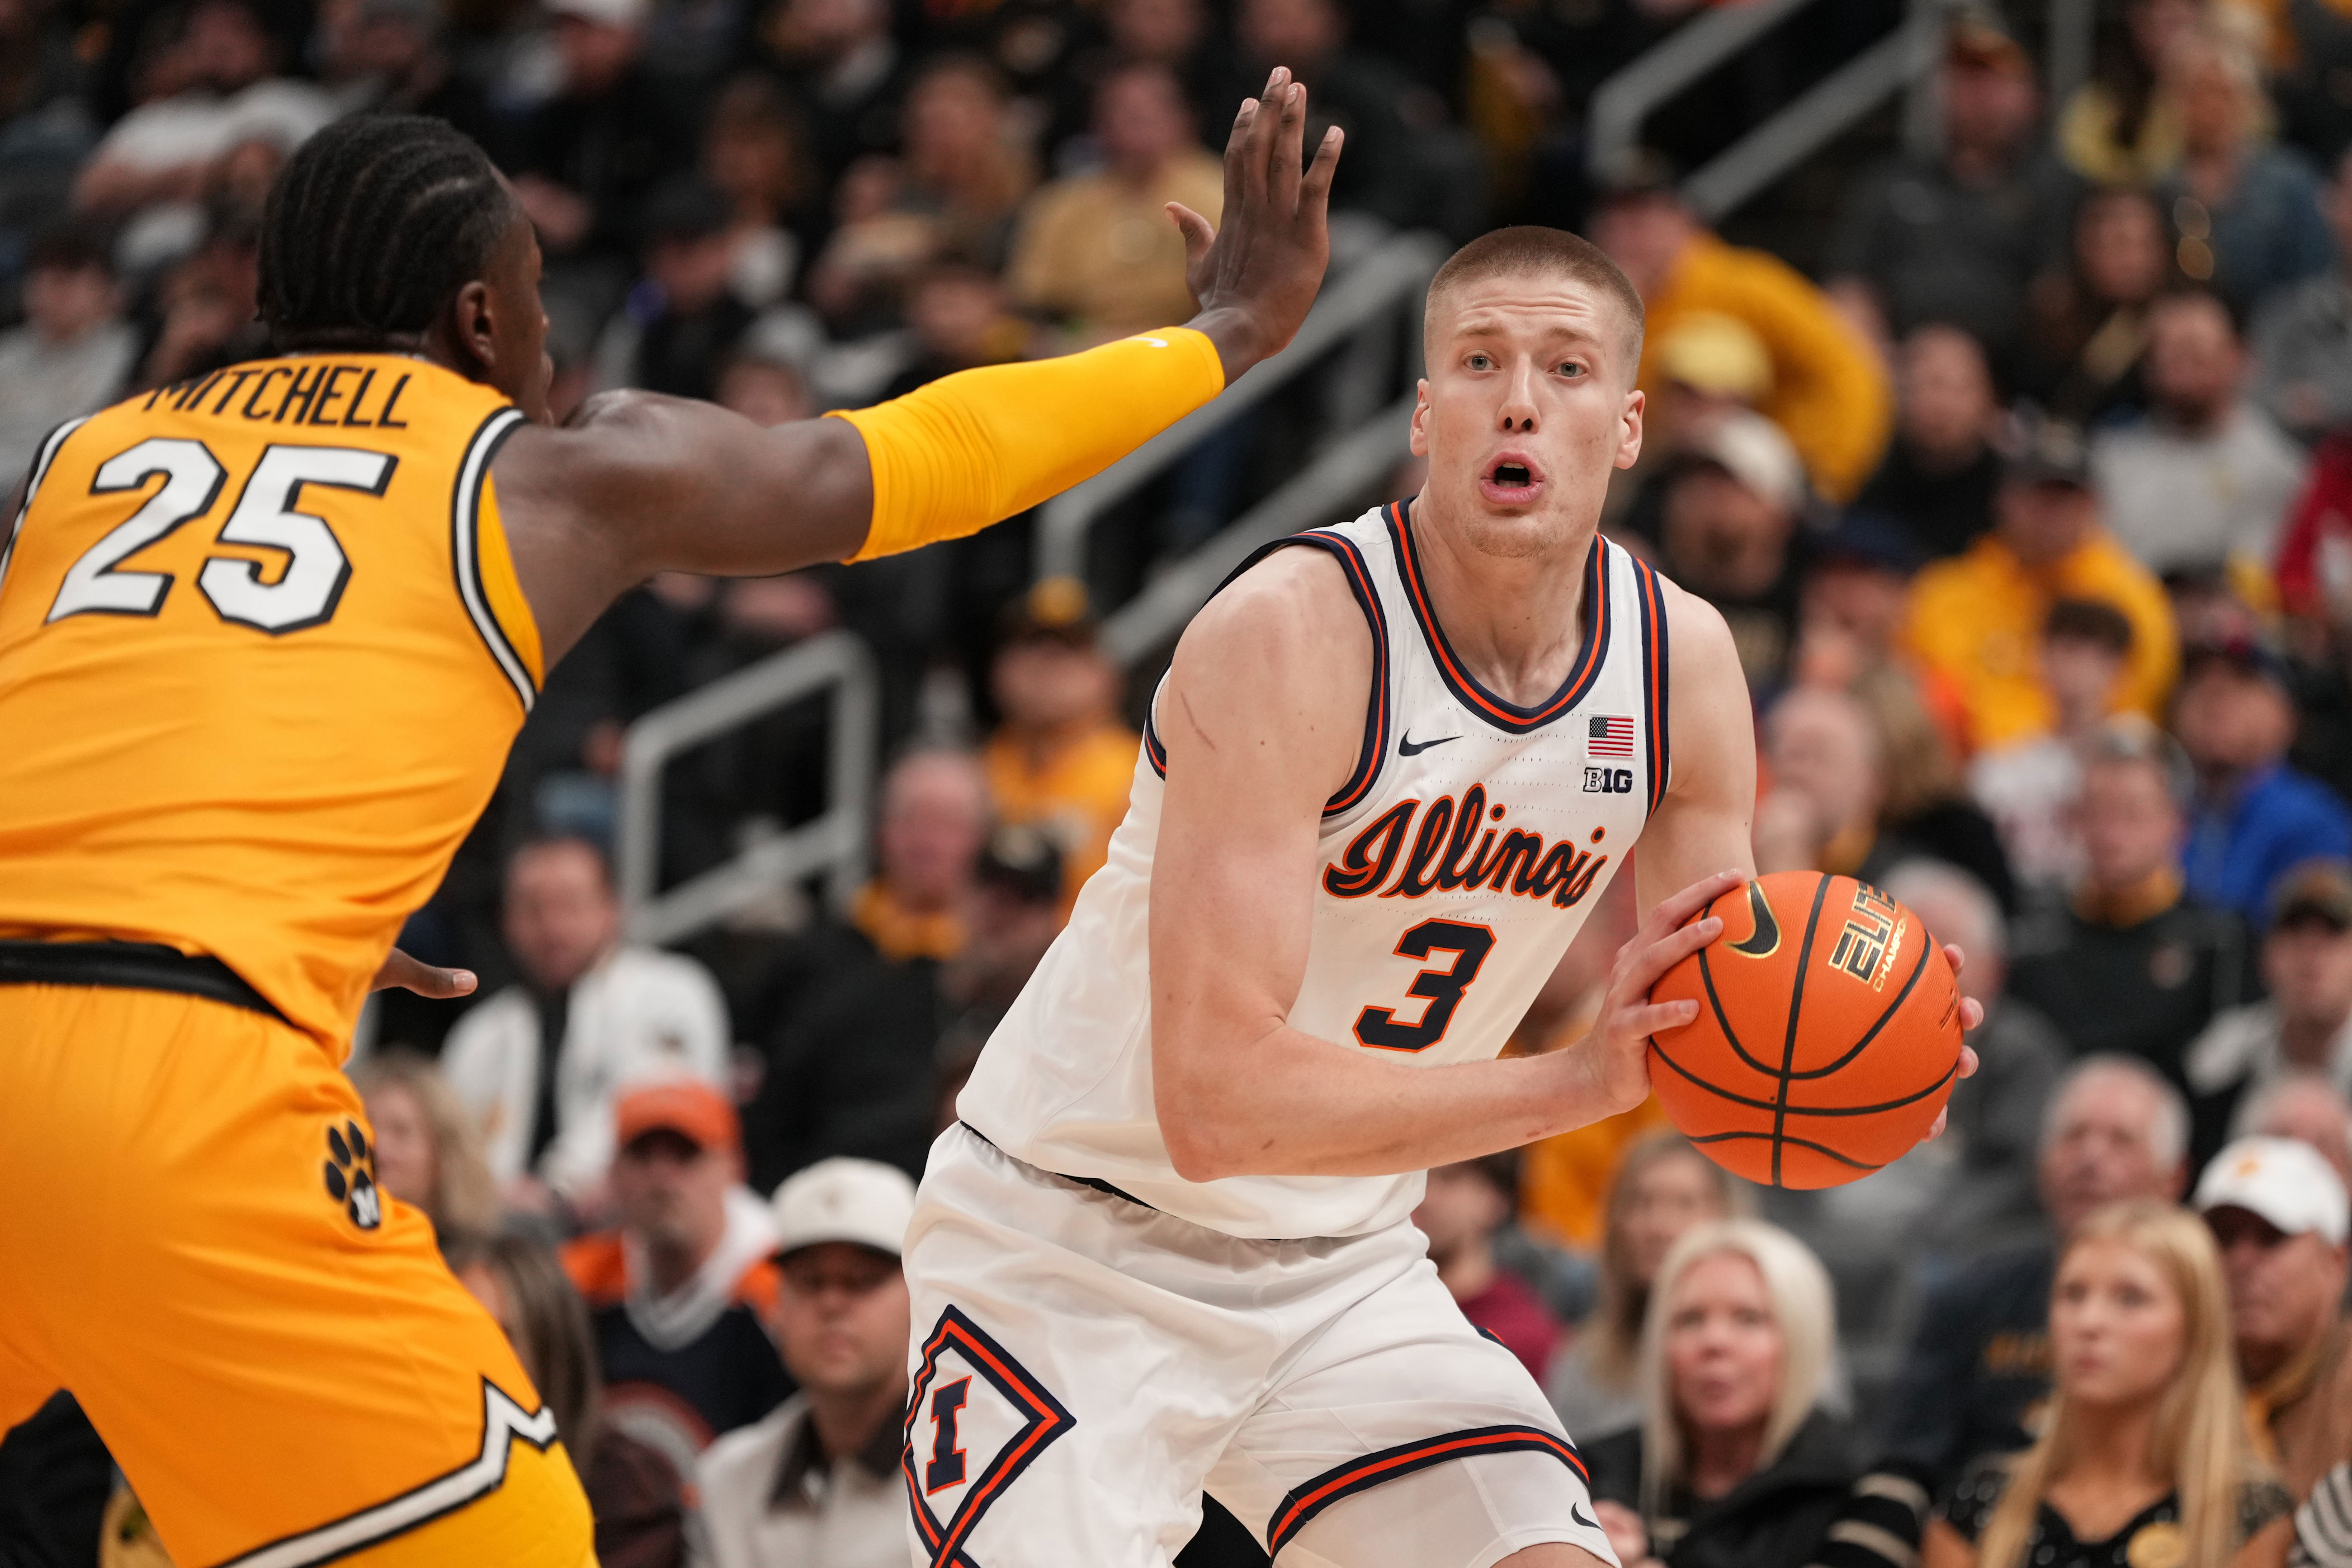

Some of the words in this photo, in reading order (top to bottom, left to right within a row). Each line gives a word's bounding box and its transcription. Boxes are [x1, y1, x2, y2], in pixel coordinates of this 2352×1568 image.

[143, 365, 412, 429] MITCHELL
[44, 436, 399, 637] 25
[1321, 783, 1608, 910] Illinois
[1352, 918, 1497, 1053] 3
[1828, 881, 1897, 985] ELITE
[926, 1375, 972, 1497] I
